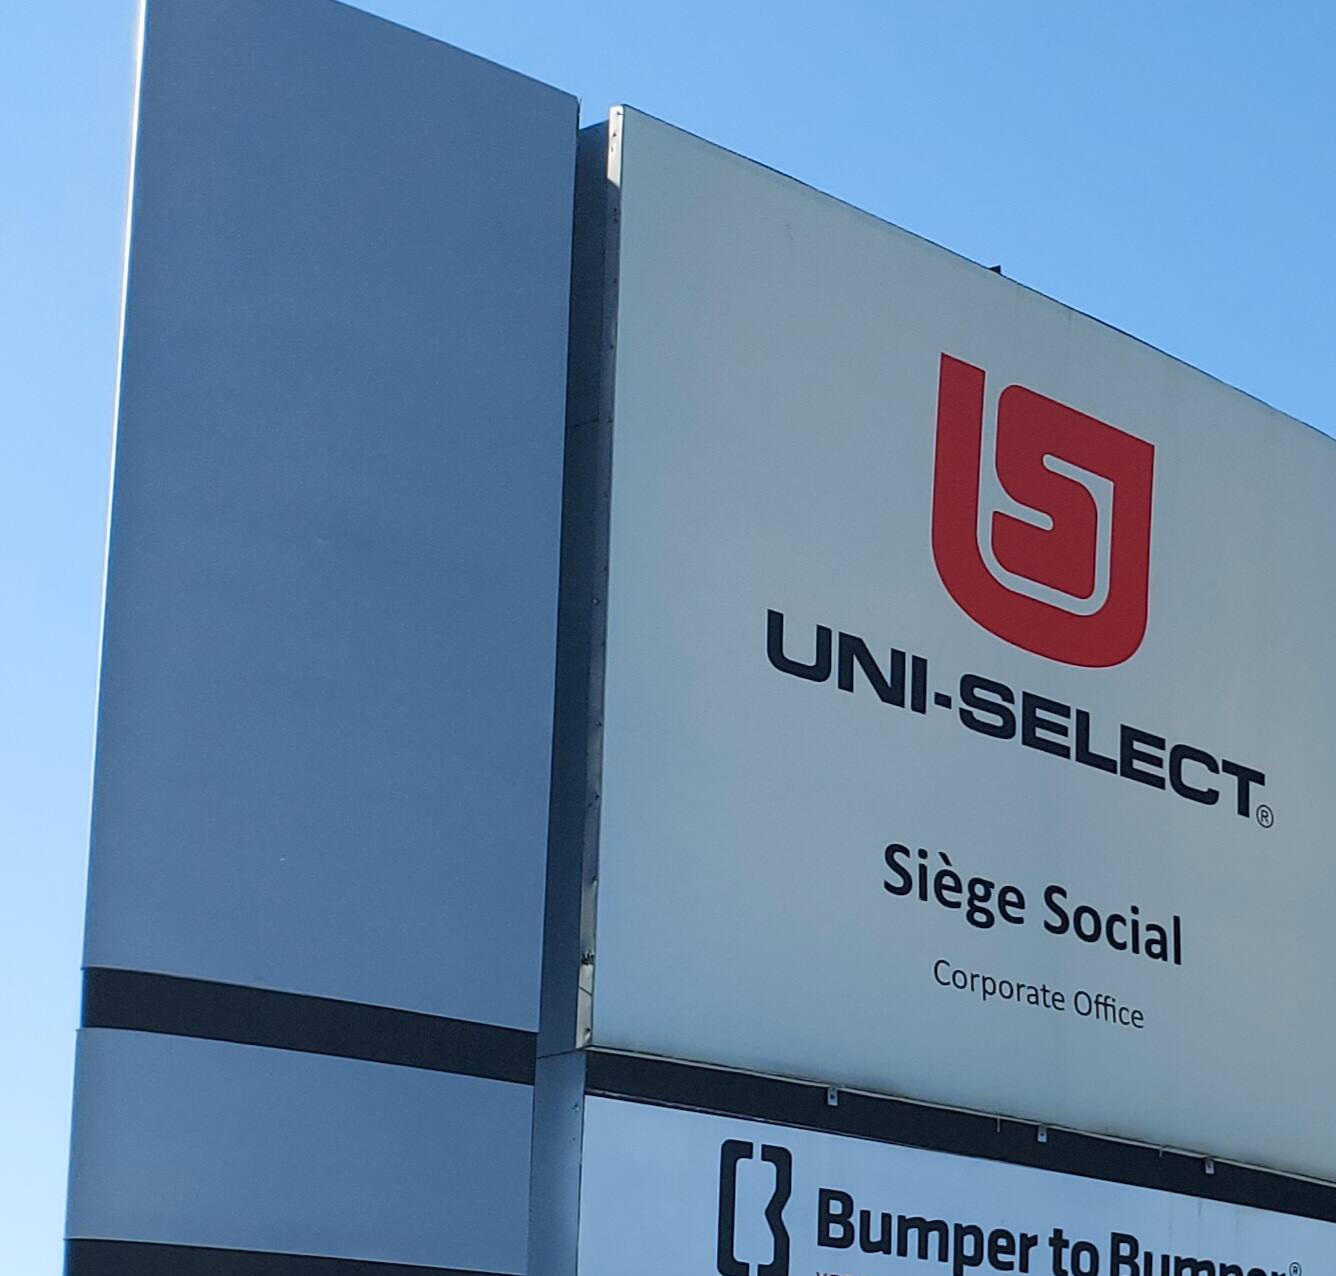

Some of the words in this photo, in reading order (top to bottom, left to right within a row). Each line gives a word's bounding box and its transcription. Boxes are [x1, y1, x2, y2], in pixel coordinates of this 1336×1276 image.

[883, 842, 1026, 929] Siège
[1043, 884, 1183, 966] Social
[932, 959, 1067, 1012] Corporate
[1073, 989, 1146, 1030] Office
